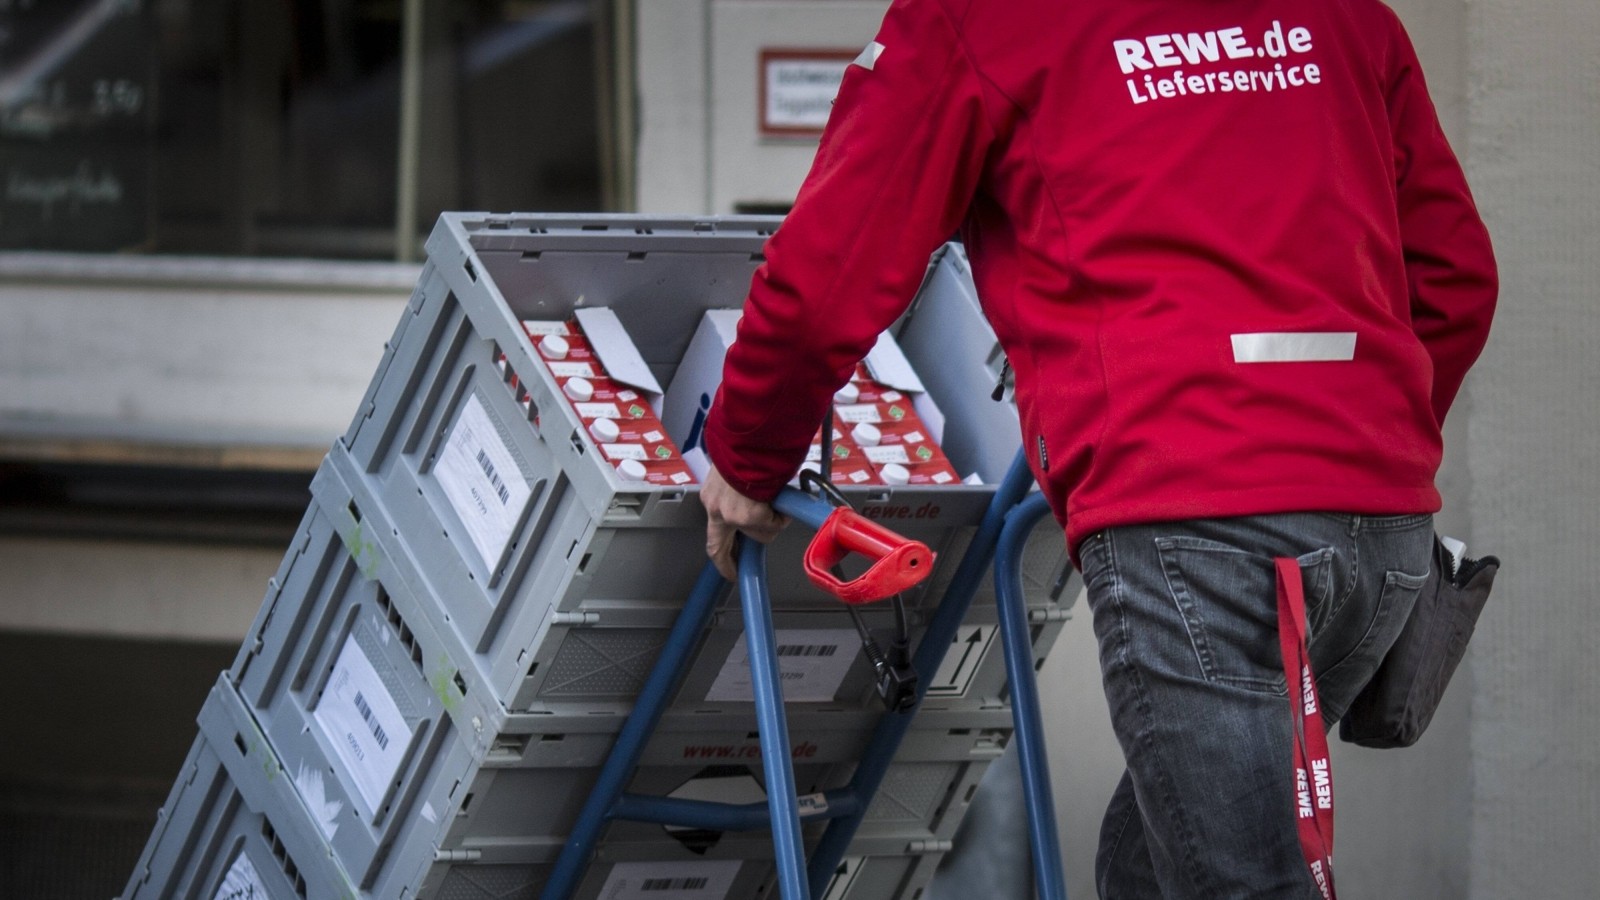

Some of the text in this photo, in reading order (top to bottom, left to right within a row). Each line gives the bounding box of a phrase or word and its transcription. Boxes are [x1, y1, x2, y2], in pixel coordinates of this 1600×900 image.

[1113, 20, 1313, 74] REWE.de
[1127, 63, 1321, 104] Lieferservice
[861, 502, 940, 519] rewe.de
[1302, 664, 1317, 716] REWE
[683, 741, 818, 759] www.rede
[1297, 768, 1313, 818] REWE
[1312, 758, 1331, 809] REWE
[1310, 859, 1331, 900] REW
